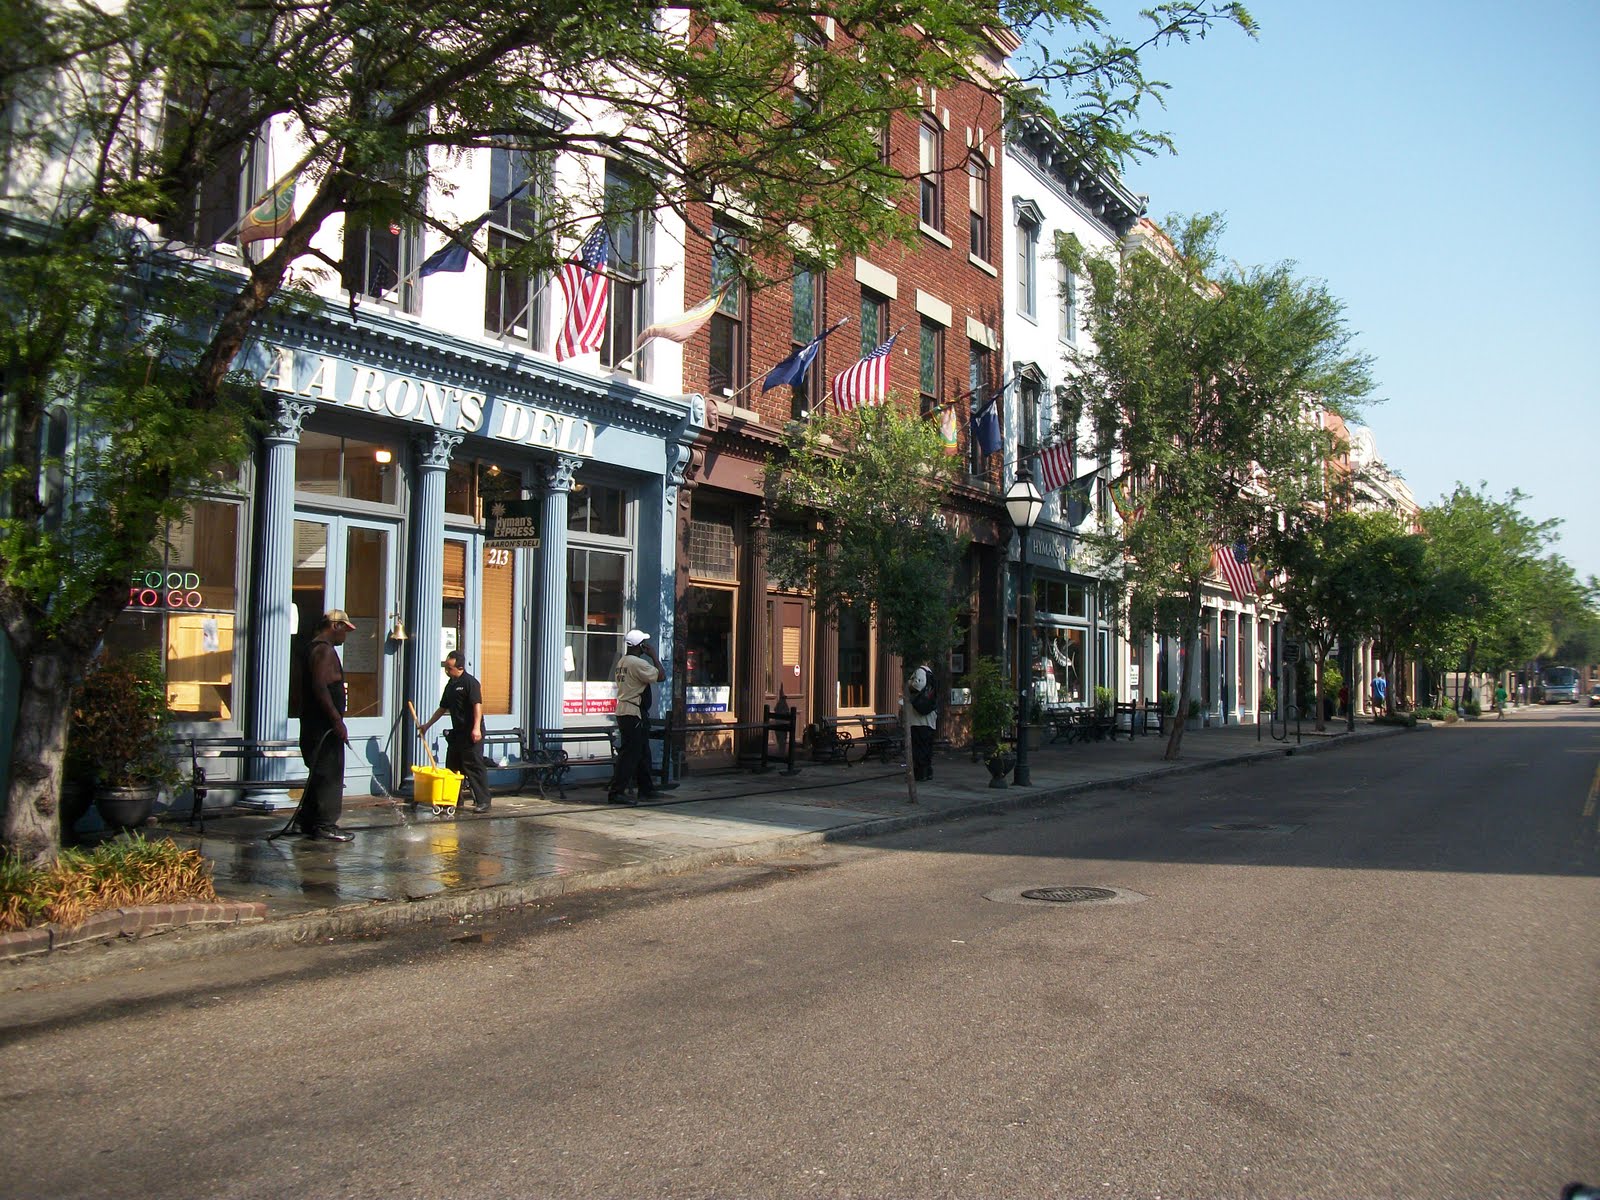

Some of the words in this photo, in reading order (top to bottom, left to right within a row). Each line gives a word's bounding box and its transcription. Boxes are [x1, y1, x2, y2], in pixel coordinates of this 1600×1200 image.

[260, 347, 488, 433] AARON'S
[495, 400, 597, 458] DELI
[496, 516, 533, 529] Hyman's
[491, 540, 521, 548] AARON'S
[488, 548, 509, 565] 213
[129, 588, 158, 606] TO
[167, 590, 202, 608] GO
